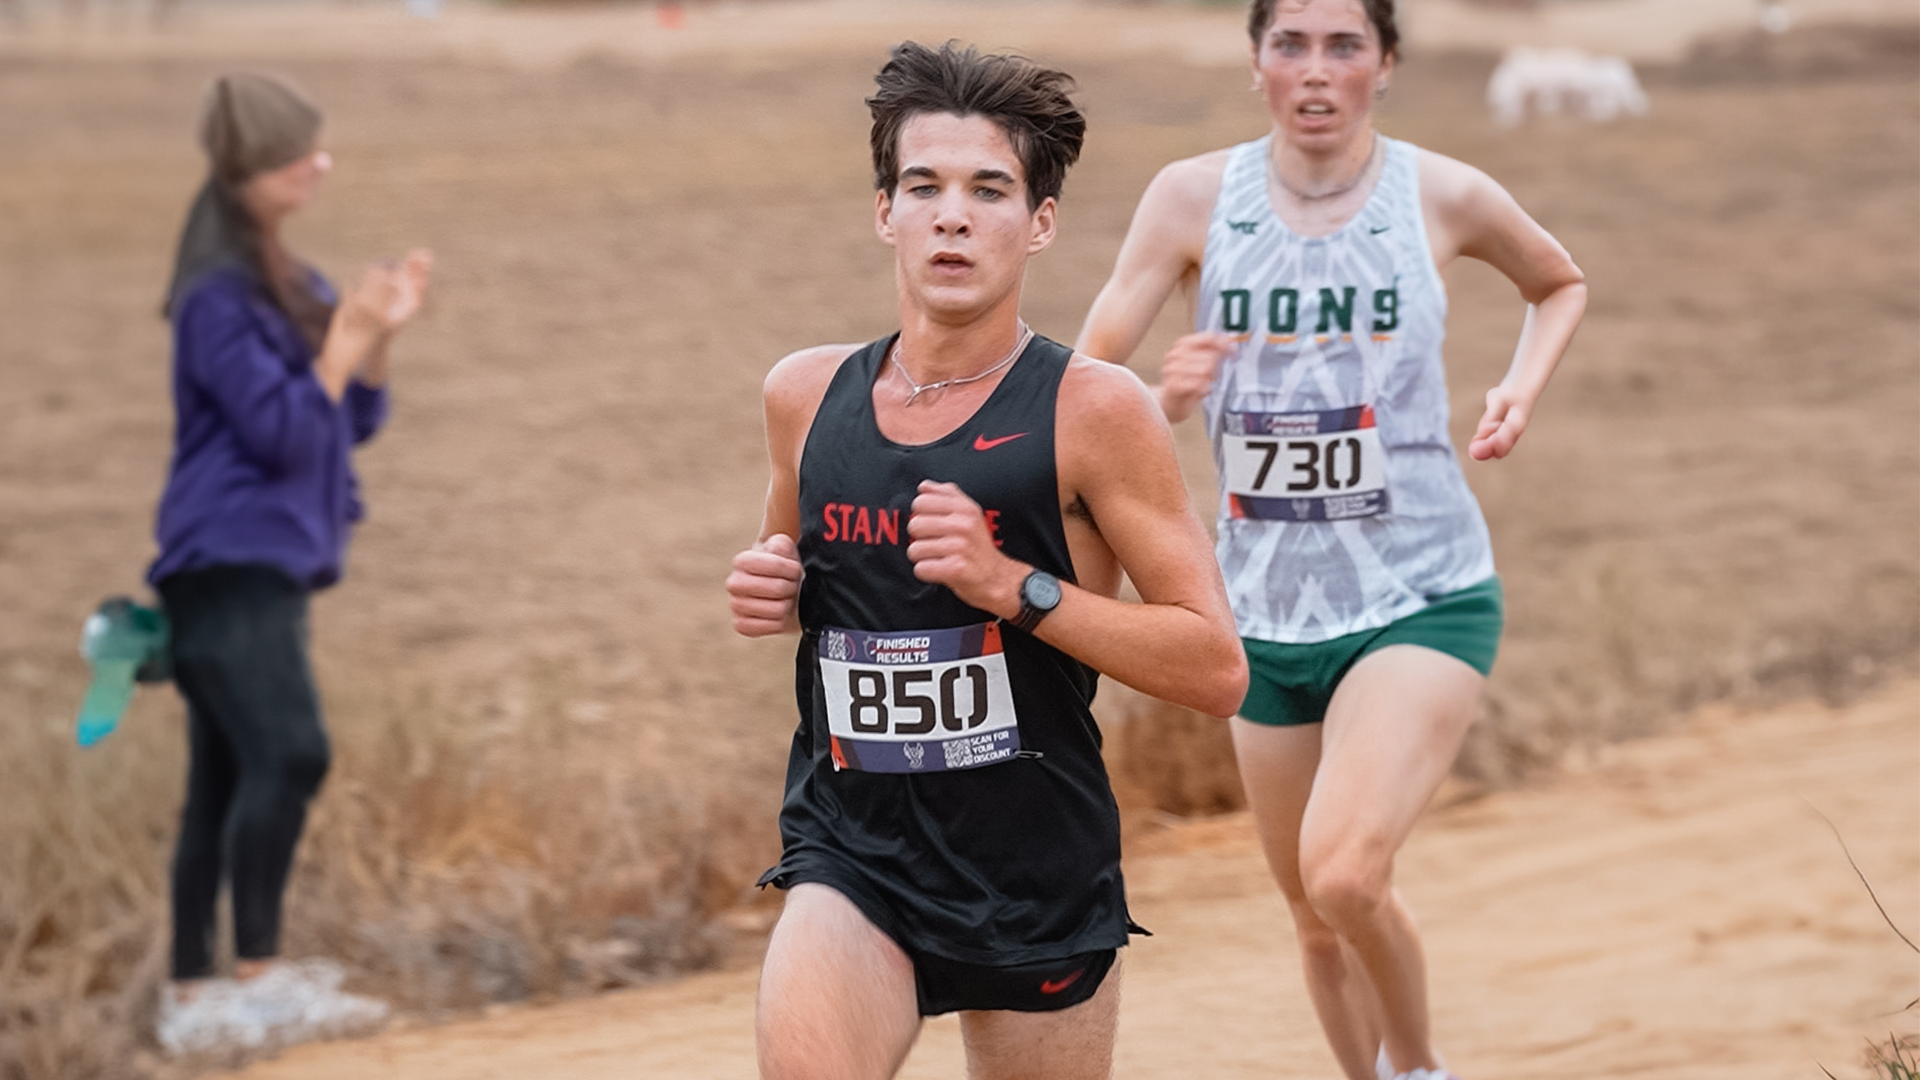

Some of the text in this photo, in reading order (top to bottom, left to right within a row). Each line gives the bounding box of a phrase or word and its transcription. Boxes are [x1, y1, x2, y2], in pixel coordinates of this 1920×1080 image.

[1245, 438, 1361, 491] 730
[876, 637, 930, 650] FINISHED
[876, 650, 929, 663] RESULTS
[848, 664, 988, 735] 850
[970, 731, 1010, 745] SCAN FOR
[972, 743, 994, 754] YOUR
[973, 748, 1011, 763] DISCOUNT
